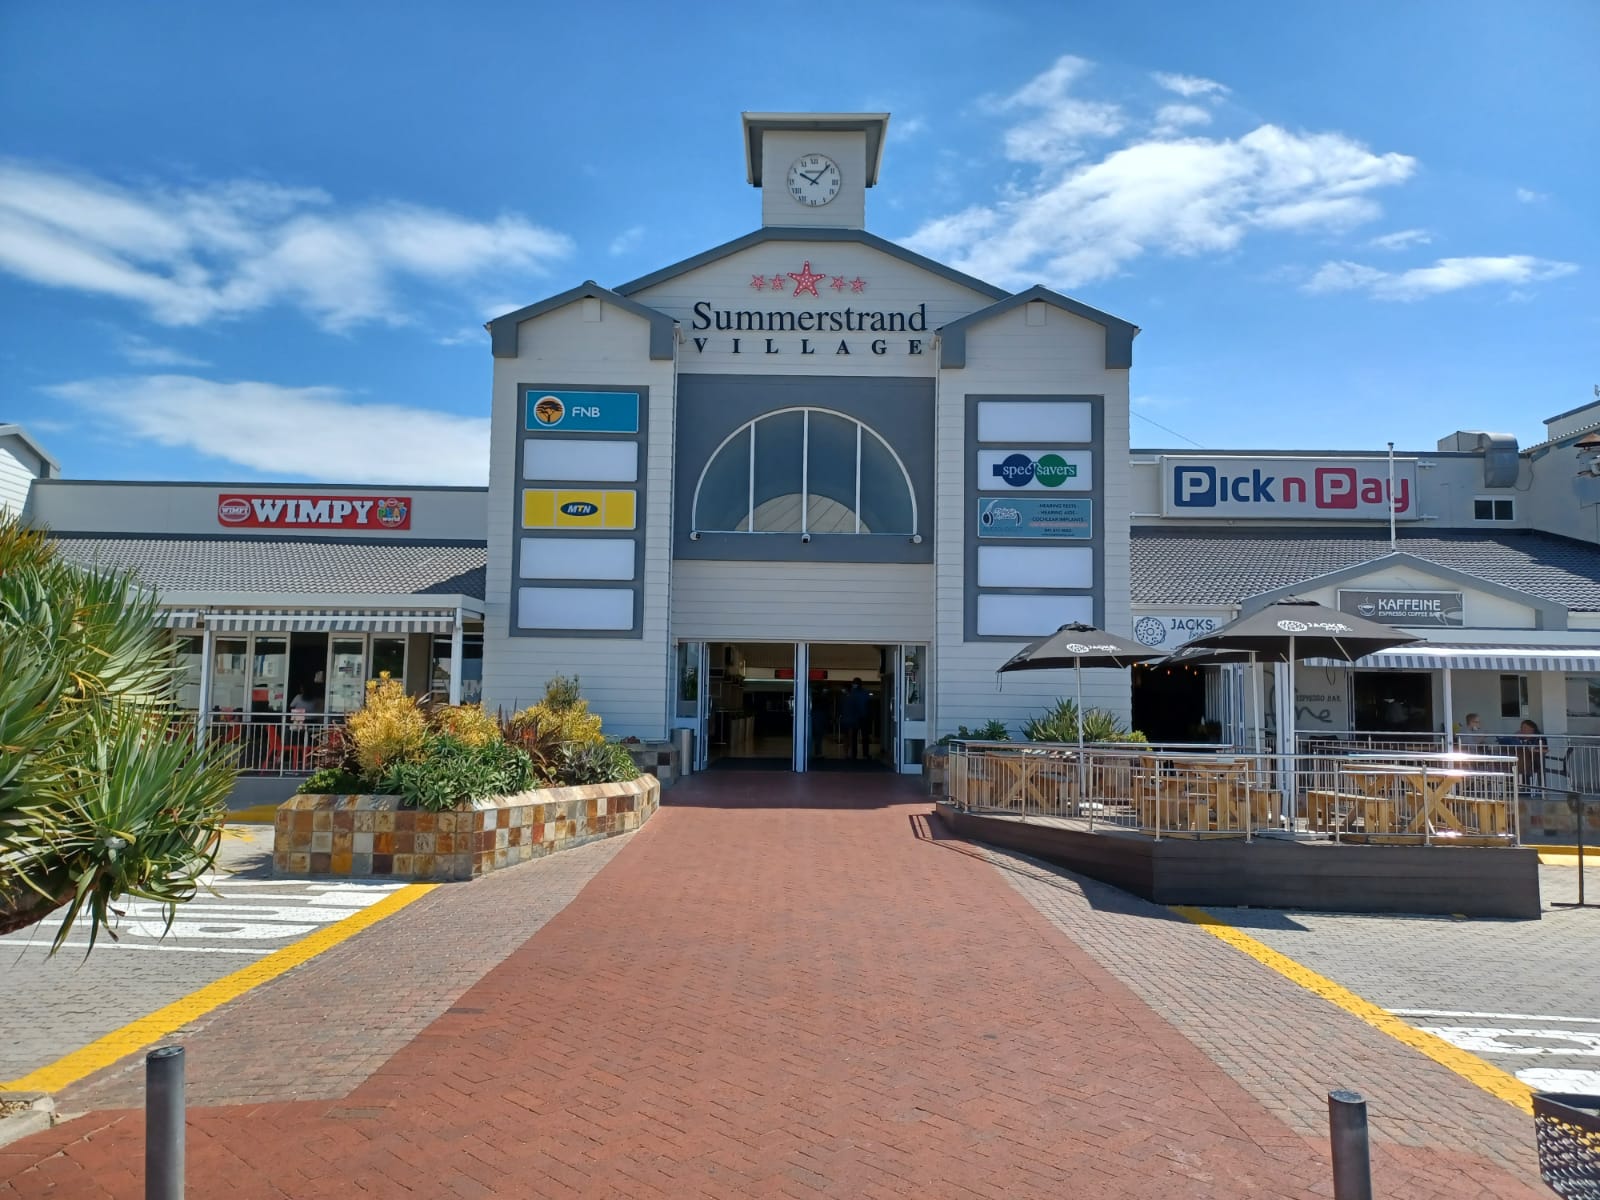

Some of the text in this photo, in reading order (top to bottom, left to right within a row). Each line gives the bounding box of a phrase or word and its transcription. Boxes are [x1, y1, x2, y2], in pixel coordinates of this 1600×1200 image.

[692, 301, 928, 332] Summerstrand
[693, 337, 923, 355] VILLAGE
[571, 406, 600, 418] FNB
[1002, 463, 1076, 479] spec savers
[1174, 466, 1410, 513] Pick n Pay
[251, 499, 374, 524] WIMPY
[567, 504, 591, 514] MTN
[1378, 599, 1441, 611] KAFFEINE
[1170, 618, 1214, 631] JACKS
